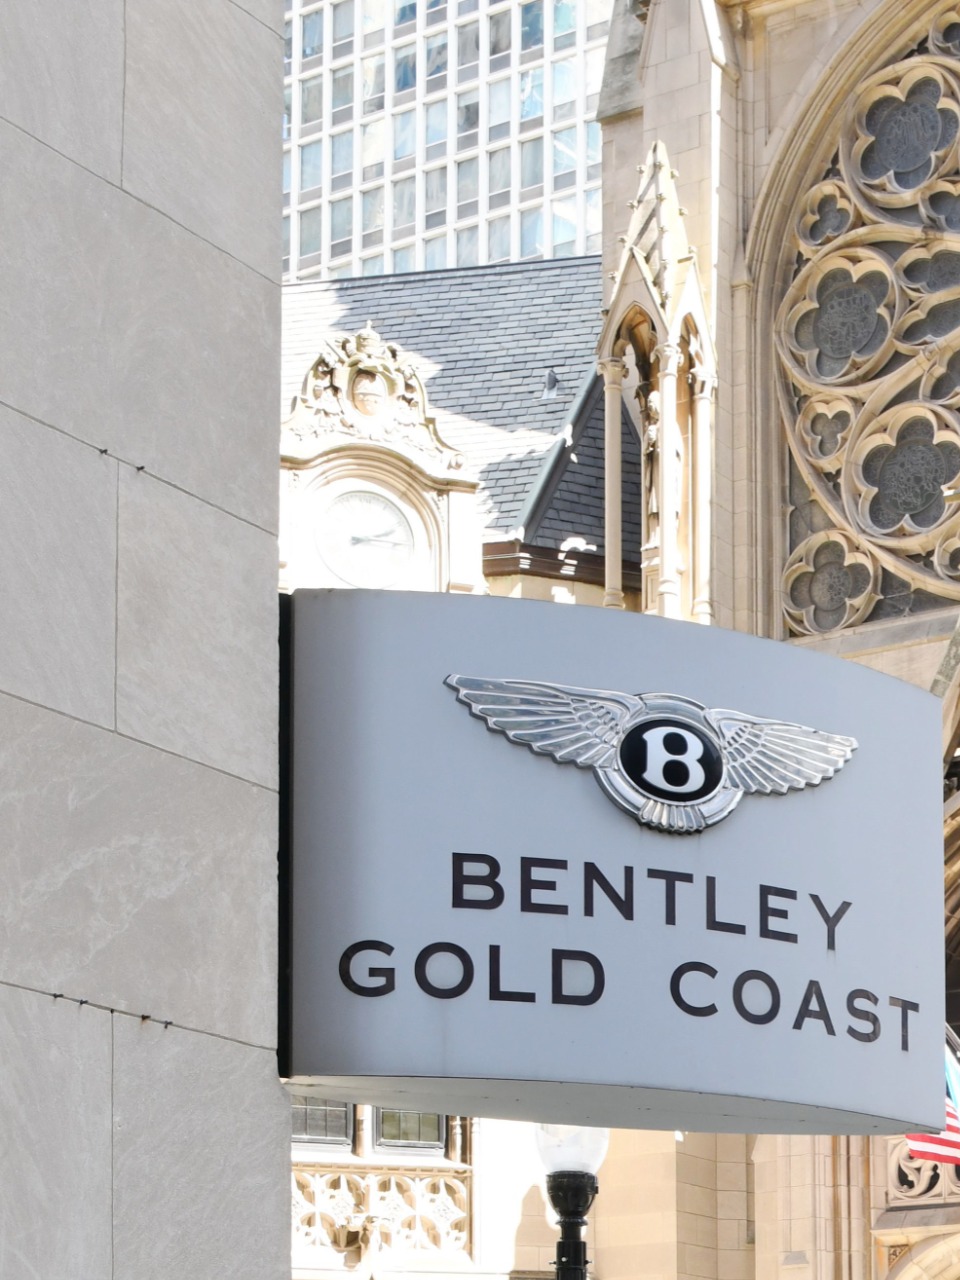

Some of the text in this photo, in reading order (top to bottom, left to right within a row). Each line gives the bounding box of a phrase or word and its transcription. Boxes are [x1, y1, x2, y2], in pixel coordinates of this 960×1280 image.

[450, 851, 853, 951] BENTLEY
[338, 939, 920, 1052] GOLD COAST
